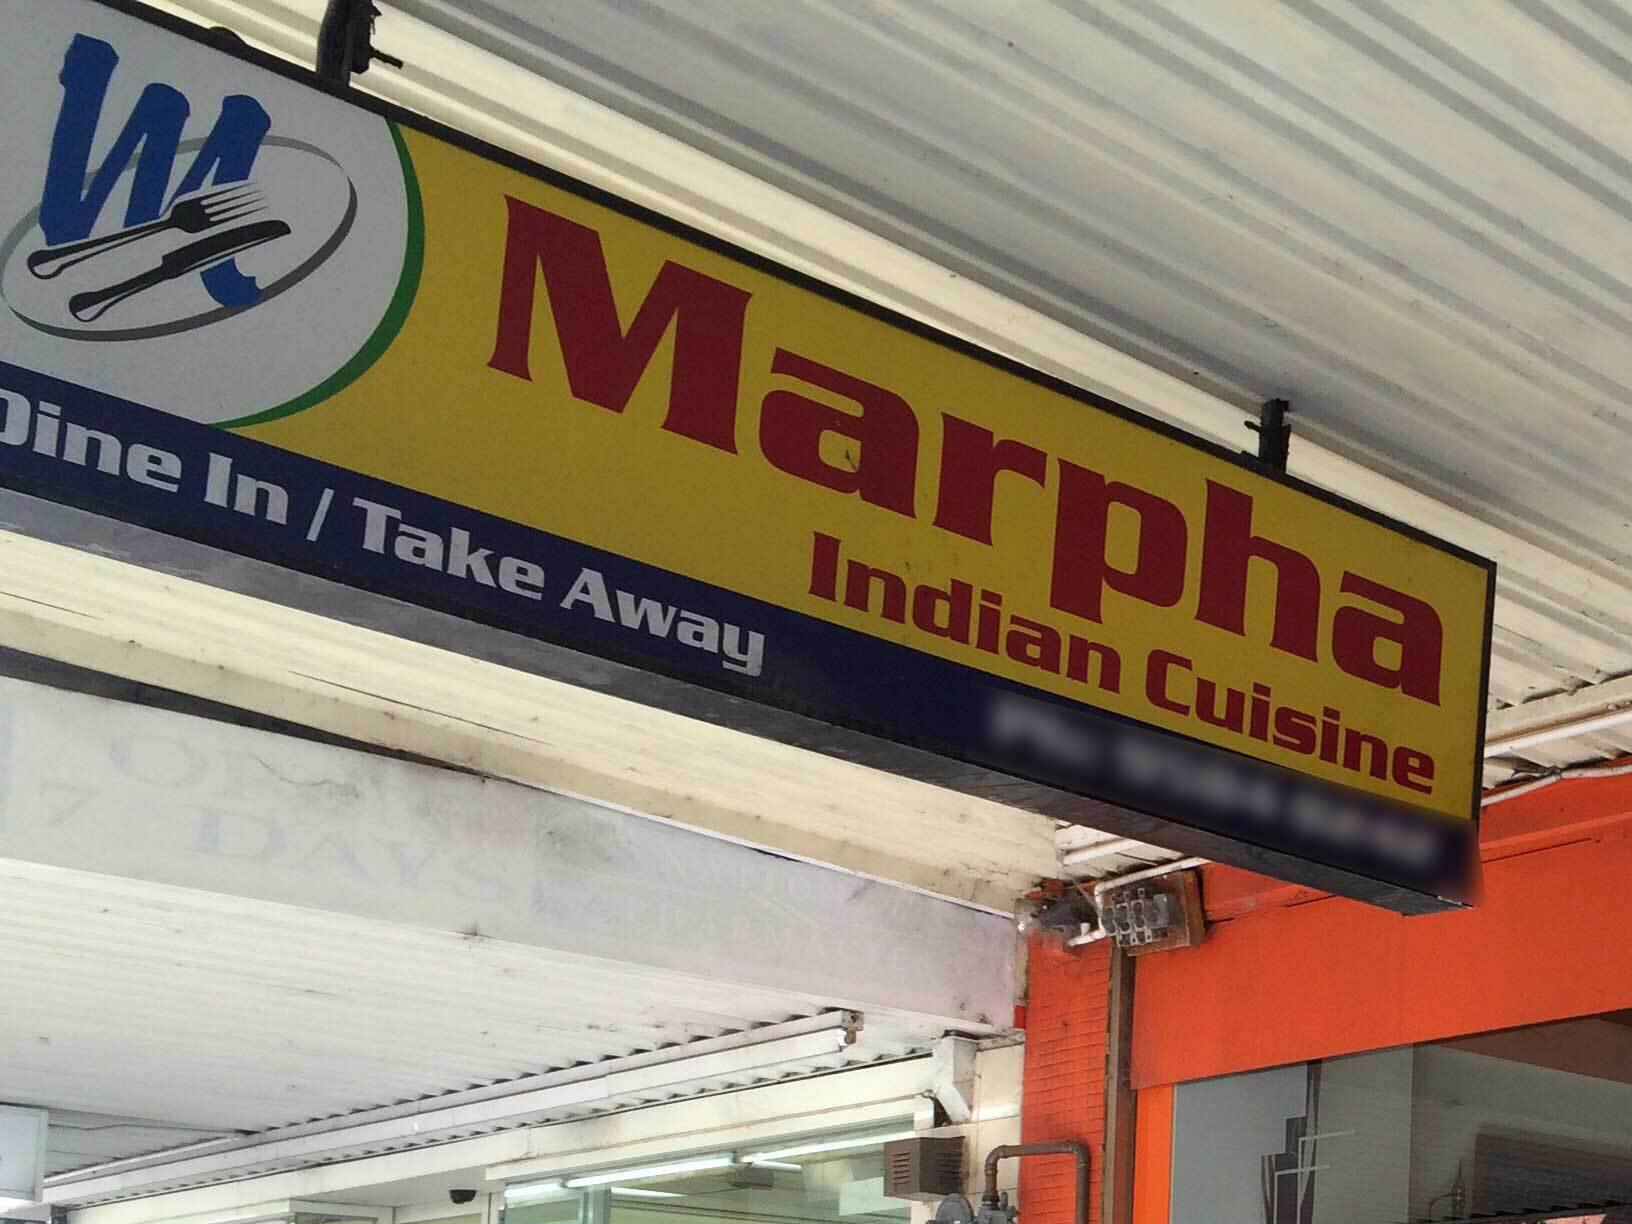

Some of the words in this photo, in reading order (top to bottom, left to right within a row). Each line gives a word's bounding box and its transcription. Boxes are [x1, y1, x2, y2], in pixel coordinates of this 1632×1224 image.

[0, 388, 182, 493] Dine
[205, 450, 289, 525] In
[306, 488, 335, 543] /
[353, 497, 543, 602] Take
[559, 567, 766, 678] Away
[487, 194, 1444, 706] Marpha
[808, 531, 1122, 694] Indian
[1145, 647, 1435, 794] Cuisine
